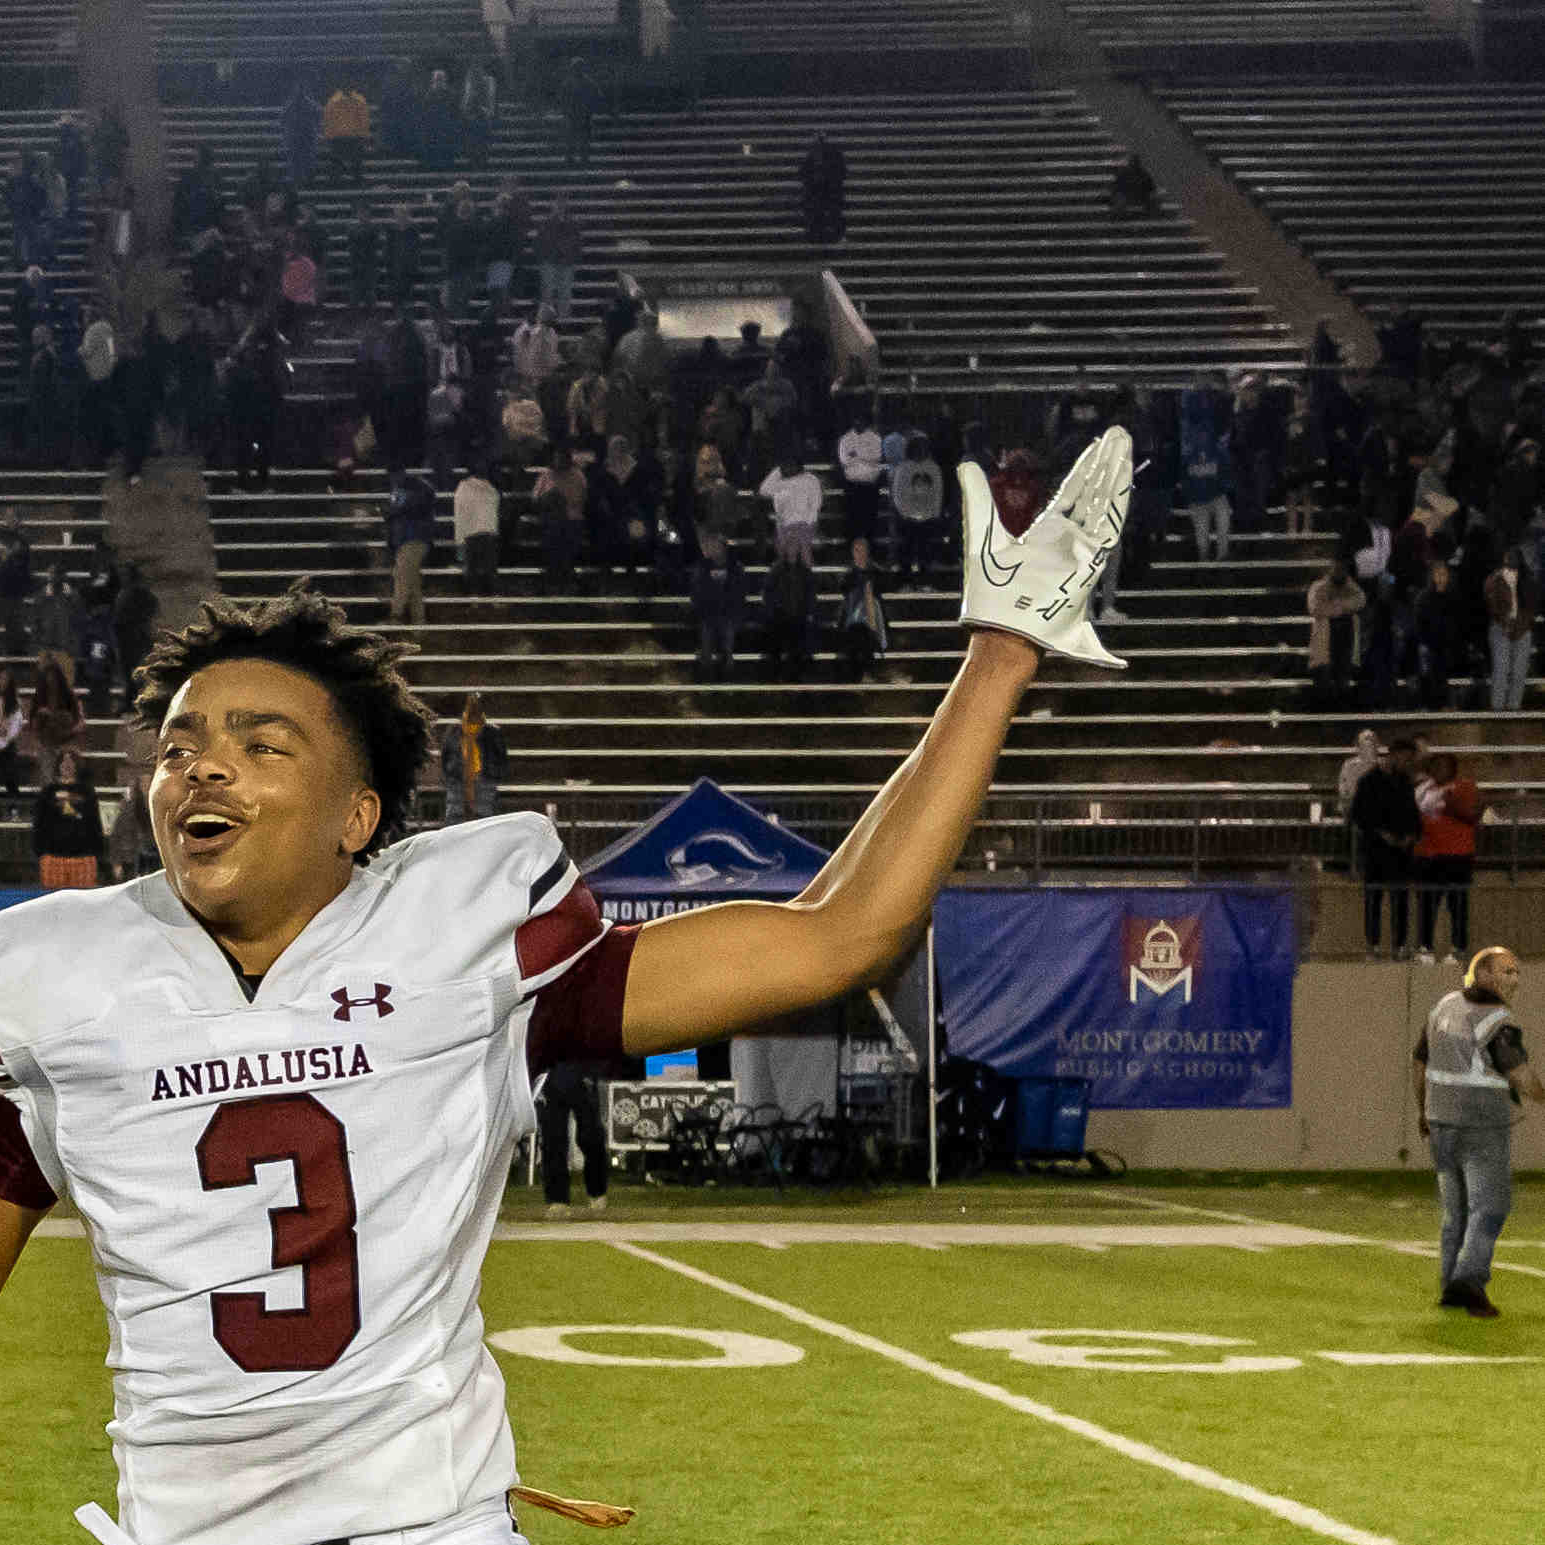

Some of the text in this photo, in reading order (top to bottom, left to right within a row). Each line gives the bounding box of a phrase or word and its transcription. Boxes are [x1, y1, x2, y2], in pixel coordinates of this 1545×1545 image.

[602, 901, 722, 921] MONTGO
[1057, 1031, 1263, 1054] MONTGOMERY
[151, 1043, 374, 1101] ANDALUSIA
[194, 1091, 362, 1374] 3
